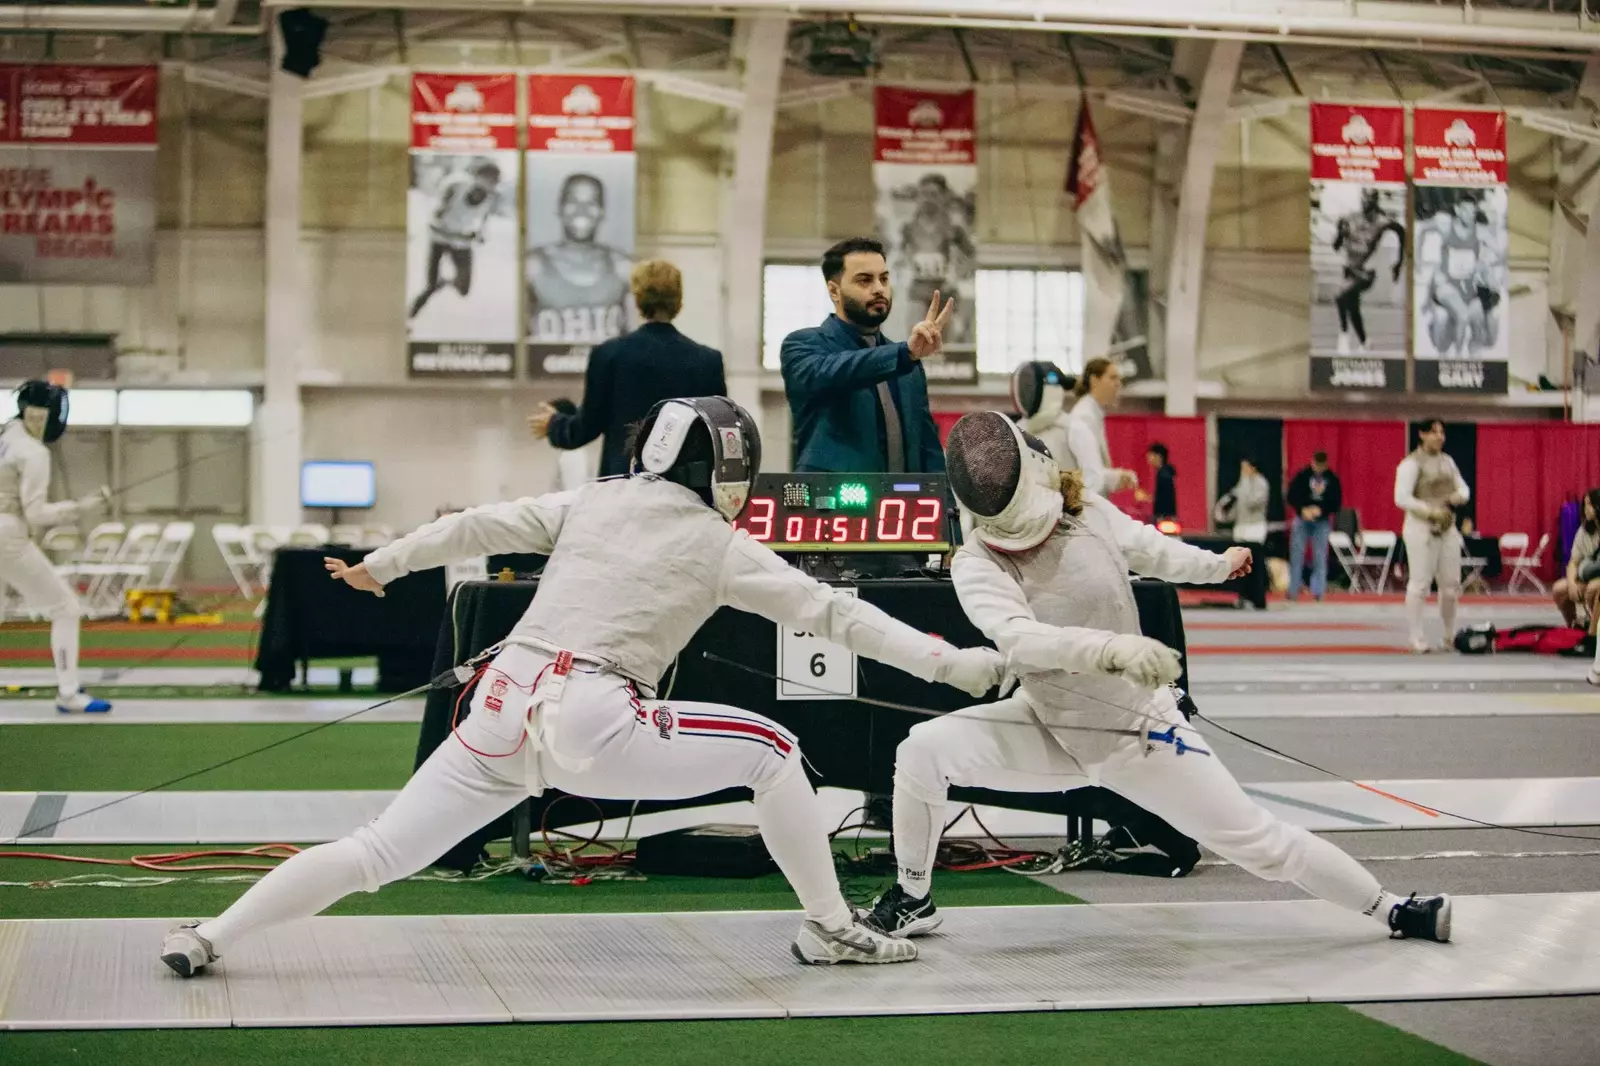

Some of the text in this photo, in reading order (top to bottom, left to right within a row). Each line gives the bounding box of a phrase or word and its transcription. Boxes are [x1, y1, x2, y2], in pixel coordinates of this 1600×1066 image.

[0, 183, 114, 211] LYMPIC
[0, 213, 114, 233] REAMS
[731, 498, 940, 542] 3 01:51 02
[810, 652, 827, 678] 6
[905, 868, 926, 876] Paul
